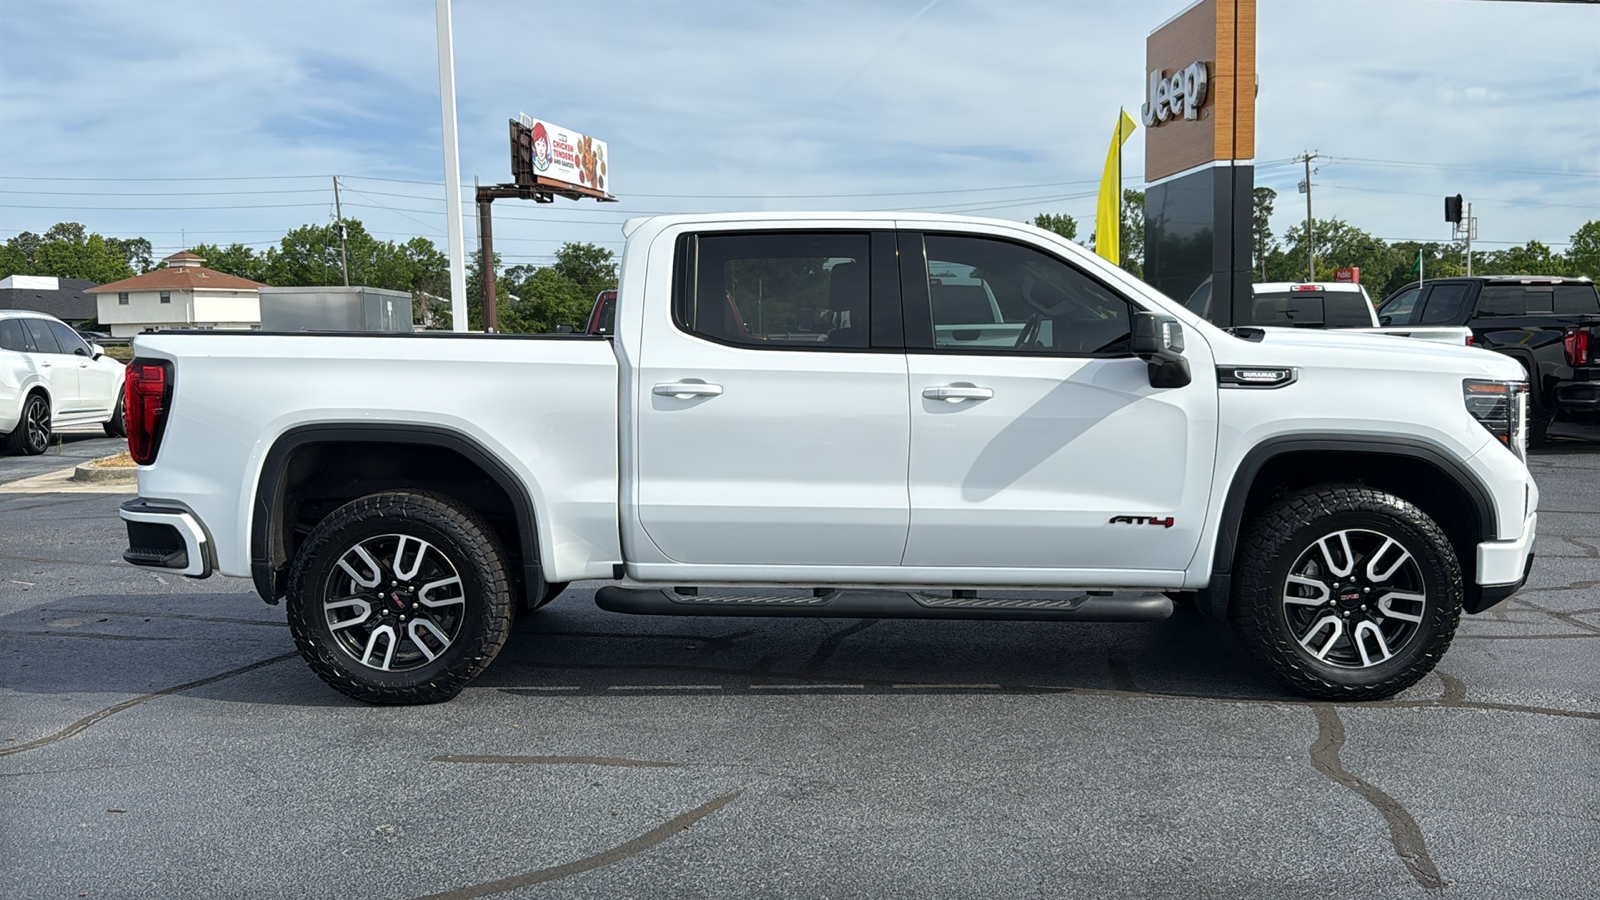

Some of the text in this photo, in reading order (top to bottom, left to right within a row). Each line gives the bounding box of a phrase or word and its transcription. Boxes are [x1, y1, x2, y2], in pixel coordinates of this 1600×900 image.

[1141, 61, 1207, 127] Jeep
[553, 140, 574, 152] CHICKEN
[553, 149, 574, 162] TENDERS
[1109, 515, 1174, 529] AT4
